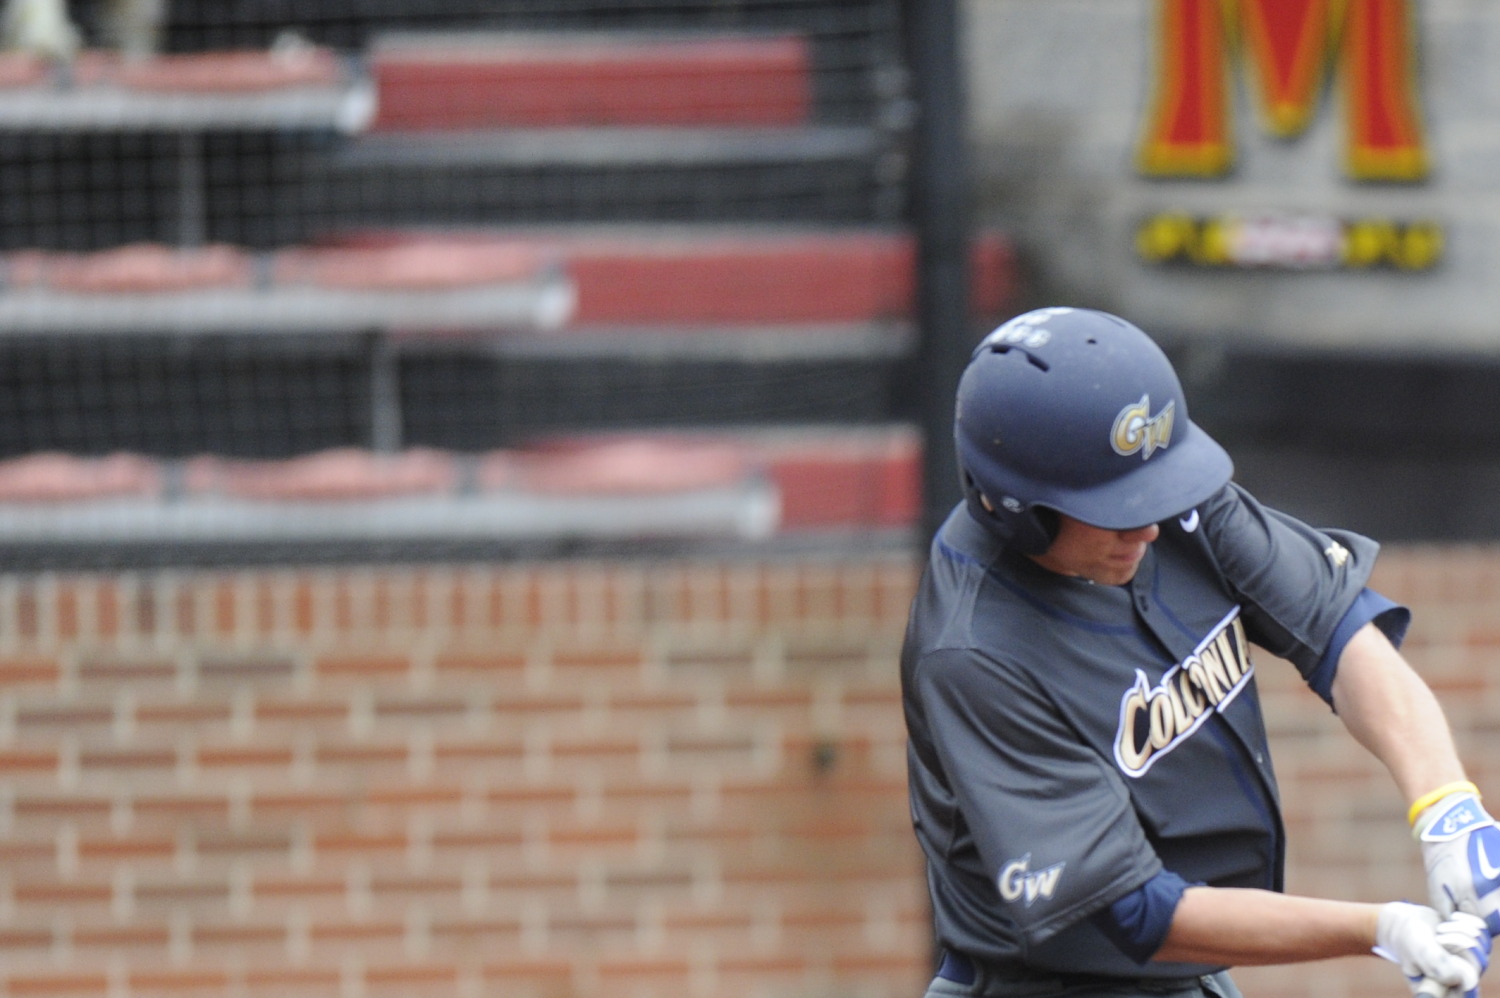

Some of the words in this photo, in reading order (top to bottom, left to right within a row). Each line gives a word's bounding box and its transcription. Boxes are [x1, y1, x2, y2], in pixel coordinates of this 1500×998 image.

[1132, 0, 1430, 181] M
[1110, 393, 1175, 460] GW
[998, 852, 1066, 908] GW
